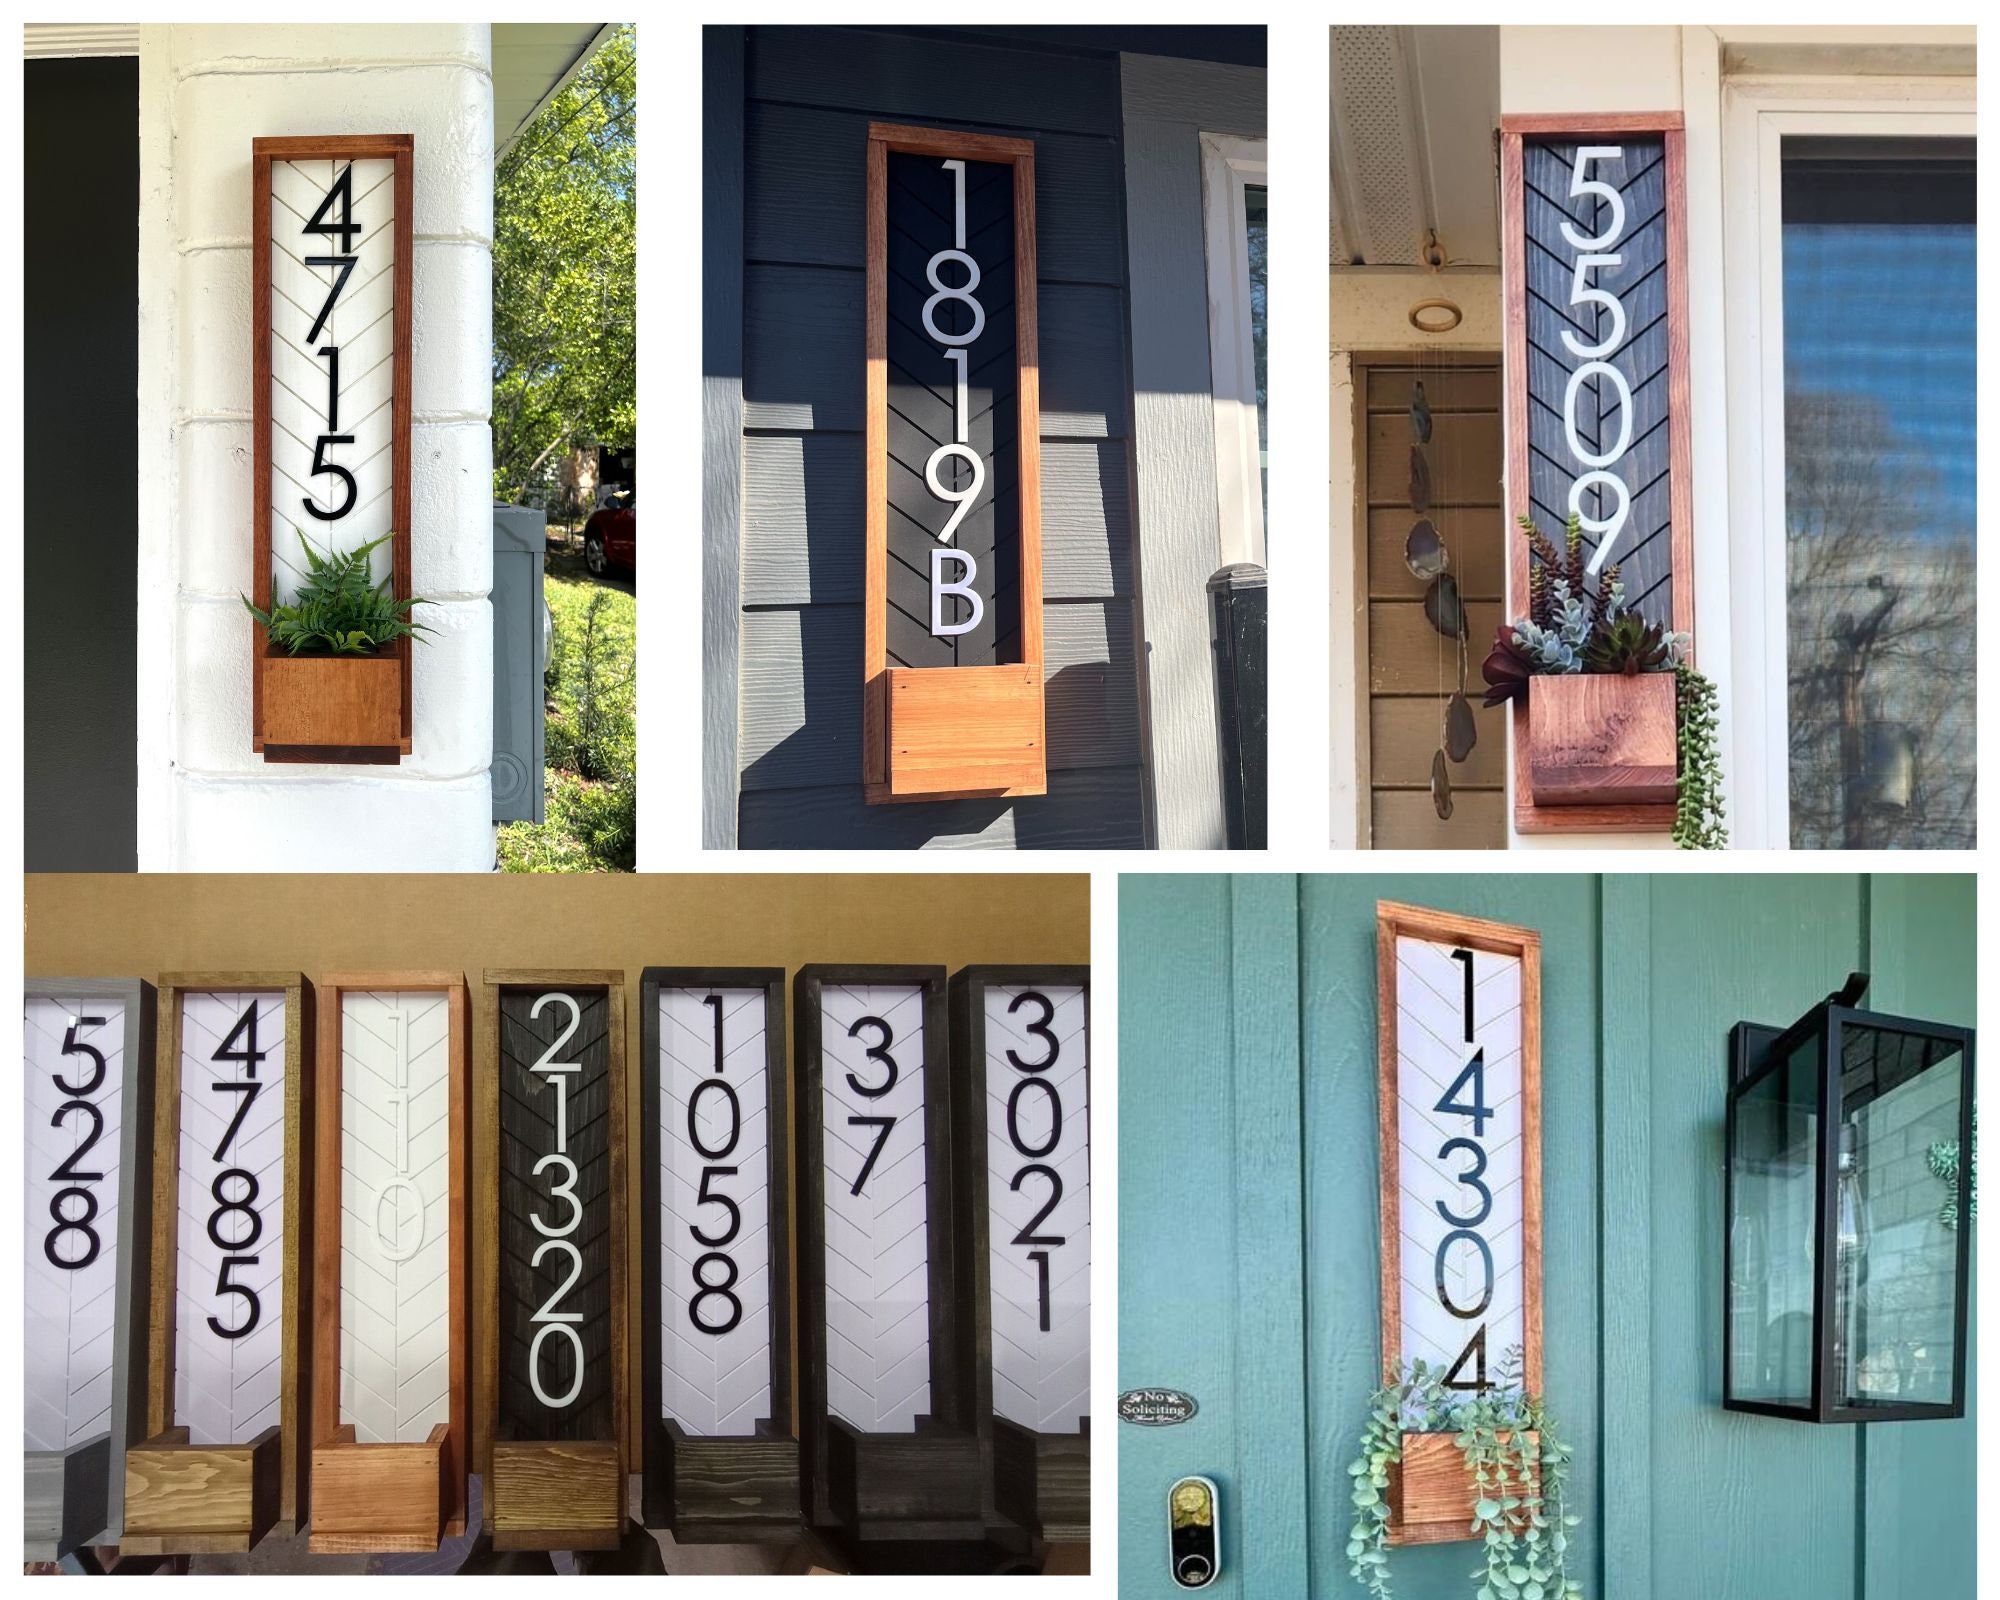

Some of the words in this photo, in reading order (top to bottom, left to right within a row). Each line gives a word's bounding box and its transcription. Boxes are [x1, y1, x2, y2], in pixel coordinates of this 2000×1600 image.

[303, 164, 361, 521] 4715
[922, 160, 985, 635] 1819B
[1560, 146, 1632, 575] 5509
[44, 1017, 107, 1269] 528
[207, 1000, 265, 1338] 4785
[374, 1009, 426, 1262] 110
[529, 993, 584, 1406] 21320
[687, 995, 743, 1333] 1058
[846, 1016, 898, 1196] 37
[1006, 991, 1066, 1331] 3021
[1433, 949, 1496, 1397] 14304
[1122, 1404, 1185, 1416] Soliciting
[1144, 1391, 1164, 1401] No
